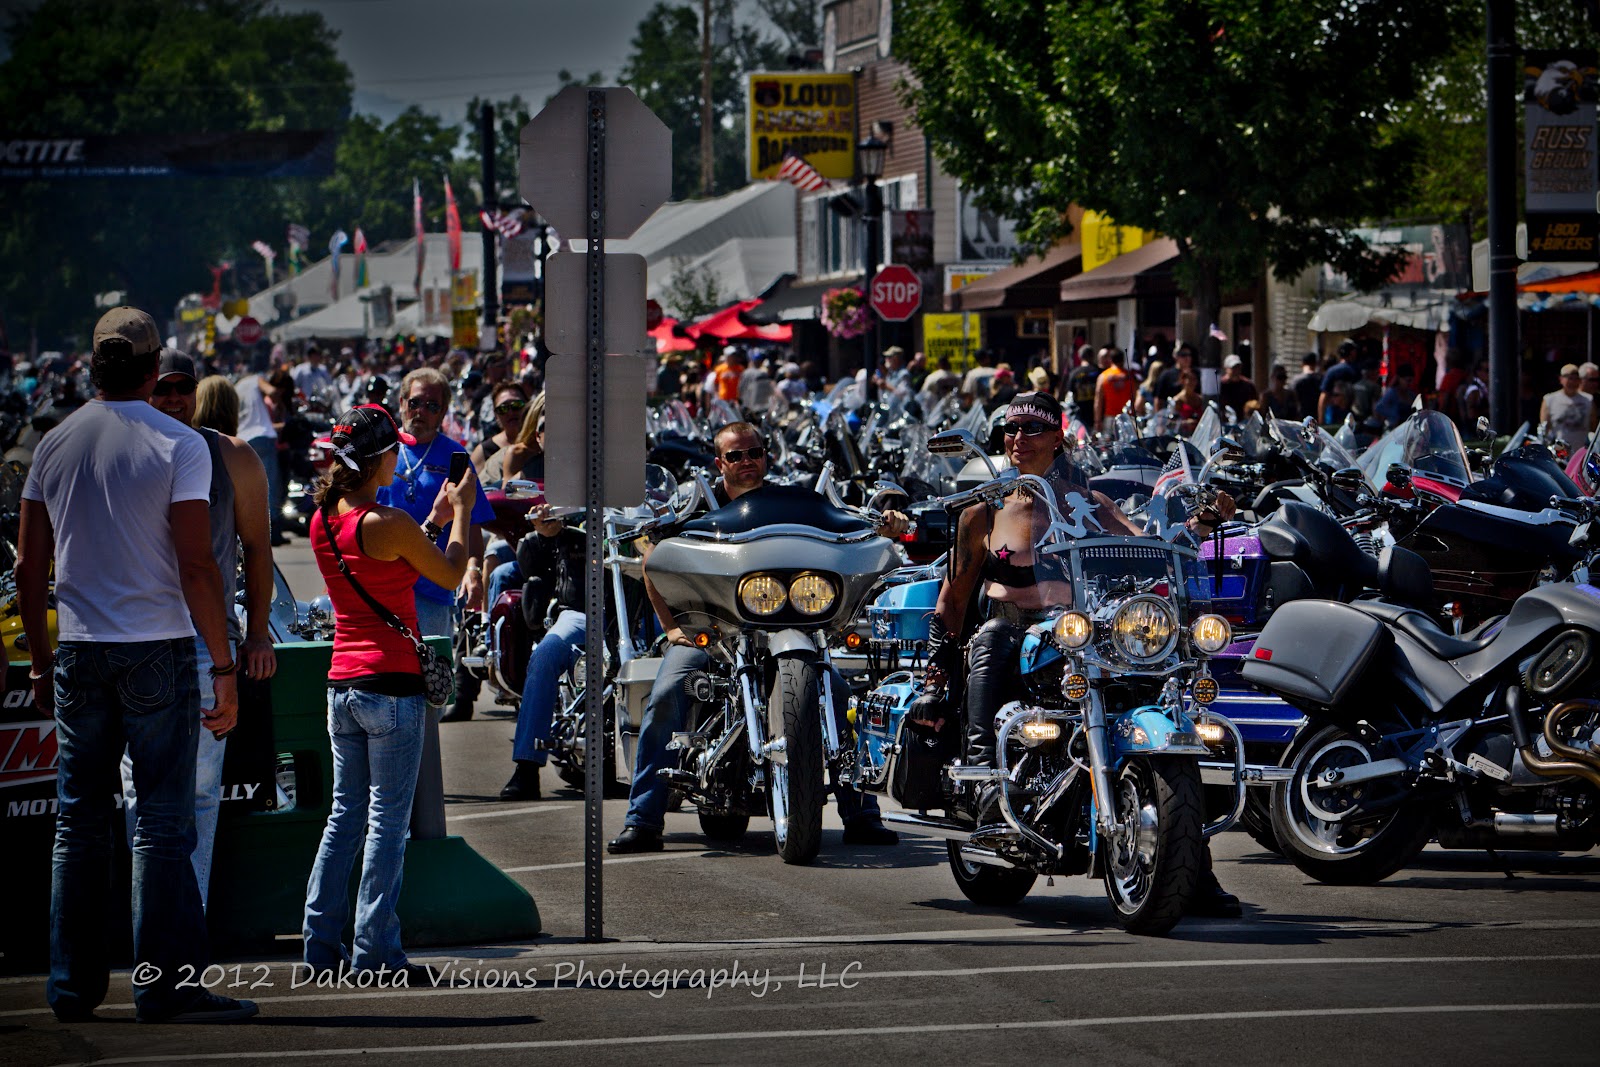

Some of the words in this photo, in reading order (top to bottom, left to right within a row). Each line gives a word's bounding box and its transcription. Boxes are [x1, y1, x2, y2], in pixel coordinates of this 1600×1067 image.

[784, 84, 851, 106] LOUD
[1531, 126, 1592, 149] RUSS
[1531, 152, 1592, 169] BROWN
[875, 282, 918, 303] STOP
